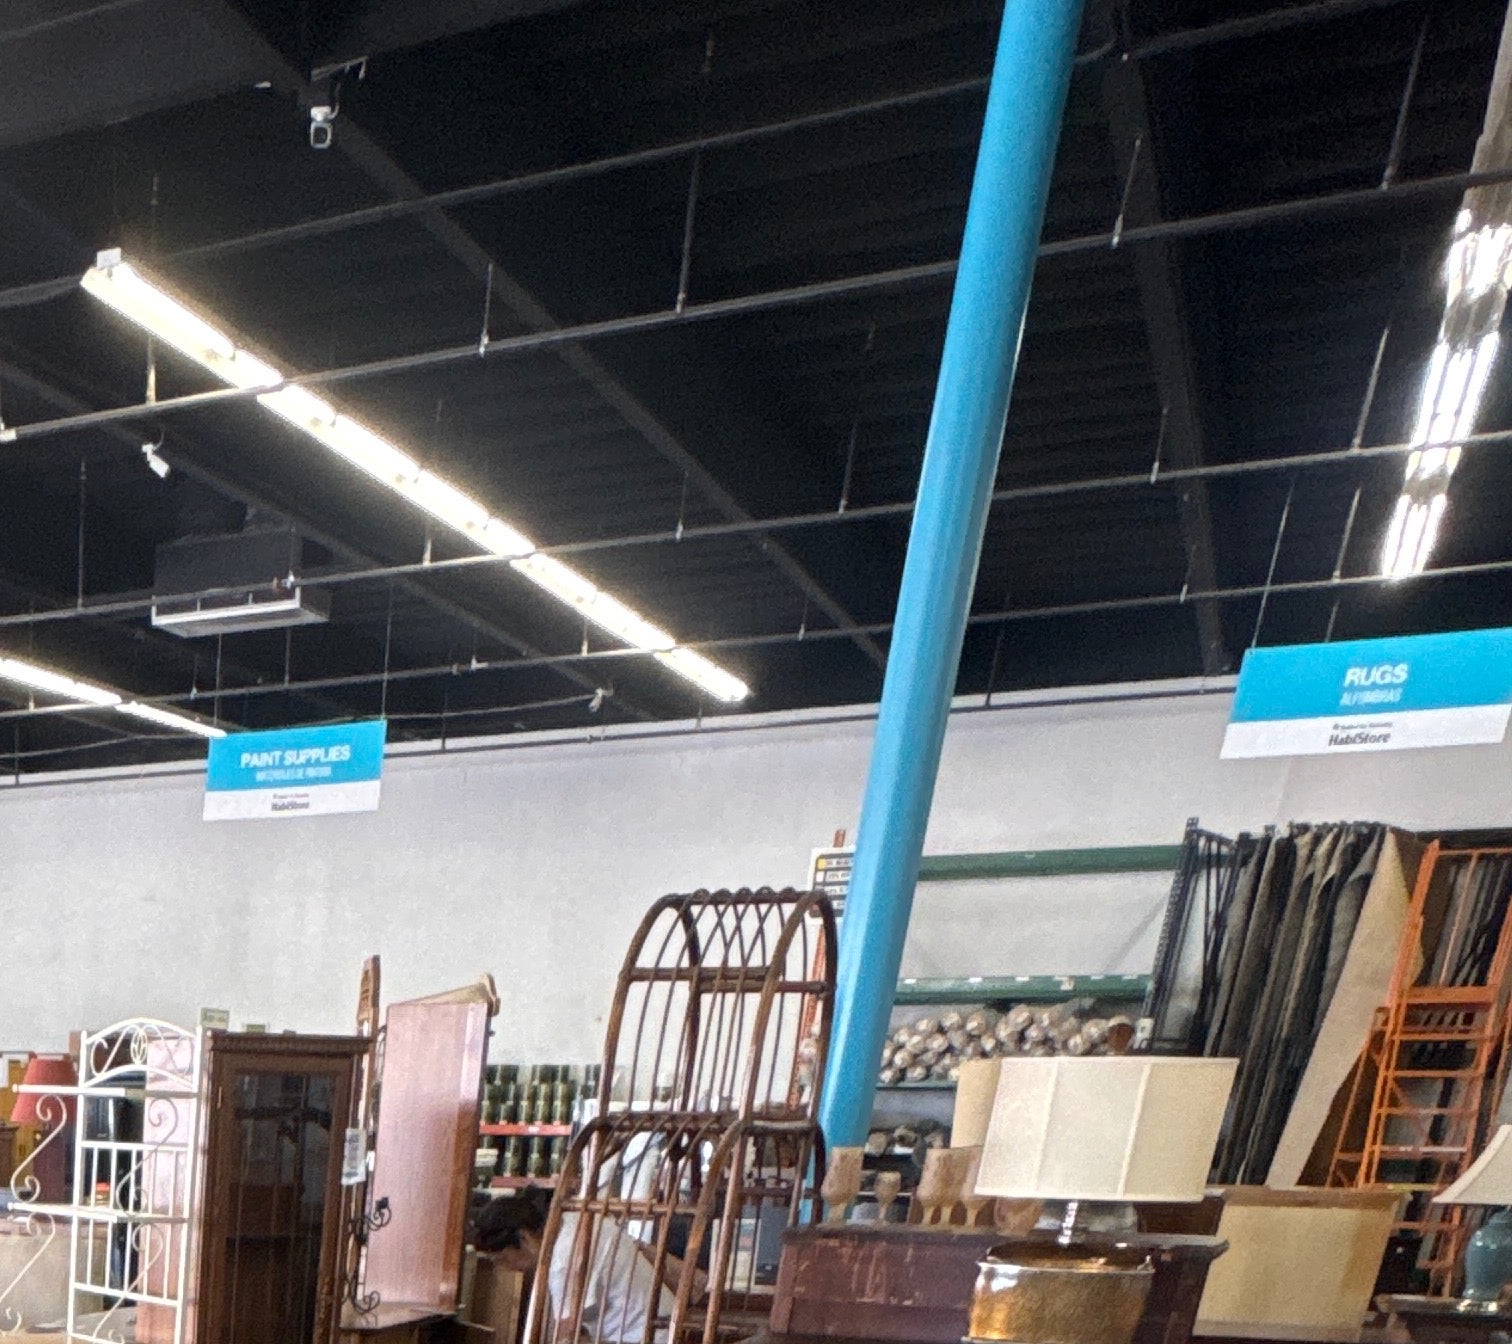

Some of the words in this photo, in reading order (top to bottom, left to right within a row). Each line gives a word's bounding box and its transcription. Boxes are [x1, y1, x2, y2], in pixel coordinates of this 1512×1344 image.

[1344, 664, 1408, 688] RUGS
[240, 750, 282, 769] PAINT
[283, 745, 351, 766] SUPPLIES
